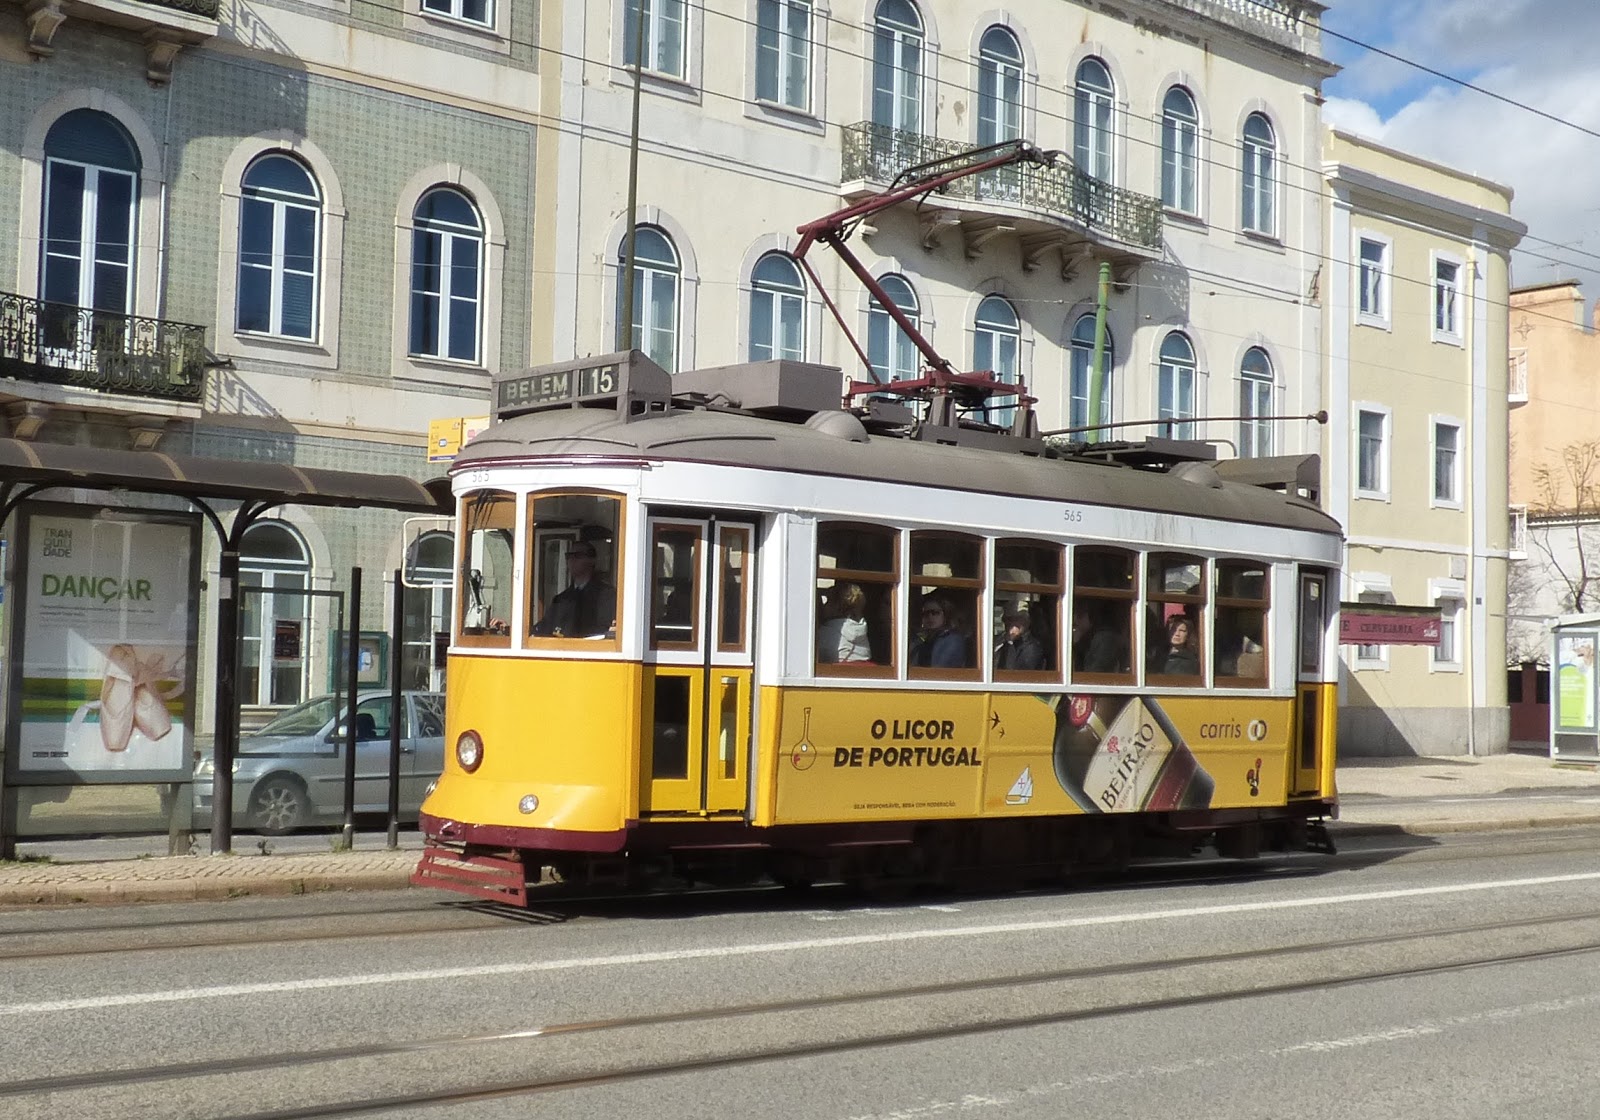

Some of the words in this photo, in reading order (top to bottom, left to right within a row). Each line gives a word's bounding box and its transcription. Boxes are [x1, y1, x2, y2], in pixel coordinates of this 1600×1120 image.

[507, 373, 568, 399] BELEM
[592, 366, 613, 394] 15
[1064, 509, 1082, 522] 565
[43, 528, 72, 539] TRAN
[43, 547, 72, 558] DADE
[41, 573, 152, 604] DANÇAR
[871, 719, 887, 740] O
[893, 720, 955, 740] LICOR
[1200, 718, 1241, 739] carris
[833, 747, 863, 768] DE
[869, 747, 982, 767] PORTUGAL
[1101, 723, 1154, 810] BEIRÃO
